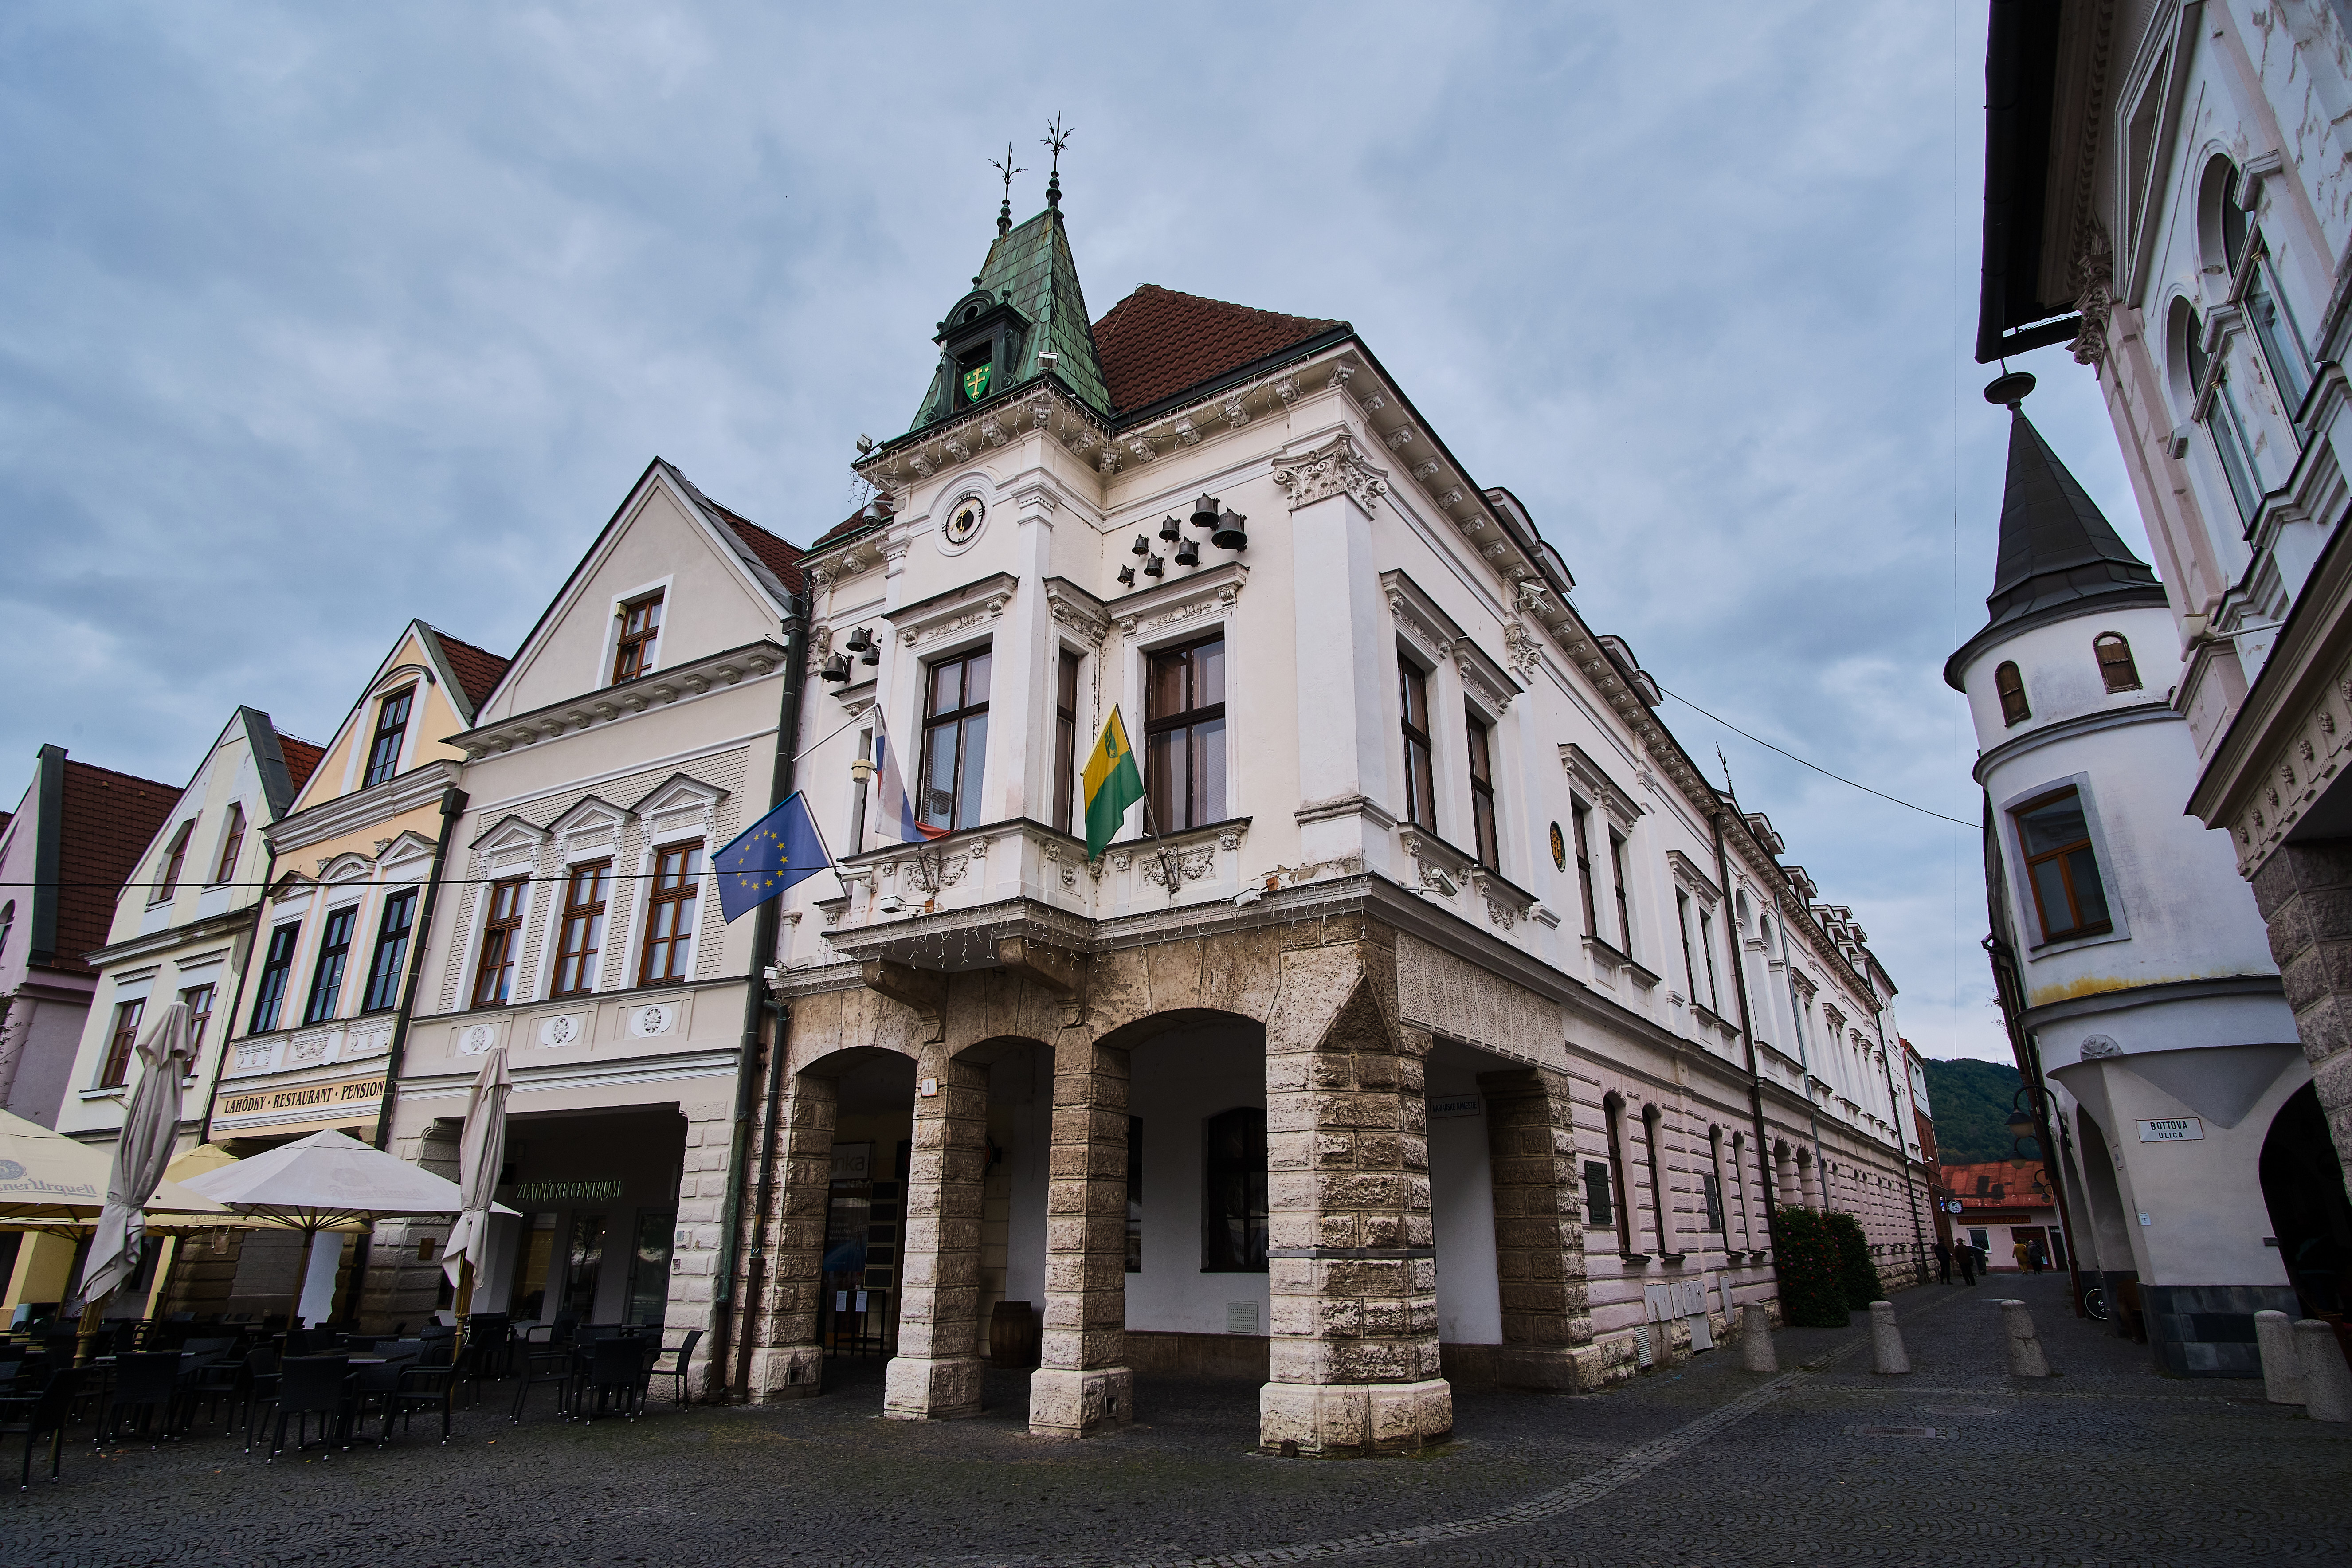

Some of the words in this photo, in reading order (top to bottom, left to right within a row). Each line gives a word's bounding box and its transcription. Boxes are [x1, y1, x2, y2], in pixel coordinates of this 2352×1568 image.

[927, 1082, 929, 1091] 1
[224, 1095, 267, 1113] LAHÔDKY
[273, 1087, 333, 1108] RESTAURANT
[341, 1081, 385, 1100] PENSION
[2150, 1121, 2188, 1130] BOTTOVA
[28, 1178, 97, 1196] Urquell
[569, 1180, 622, 1202] CENTRUM
